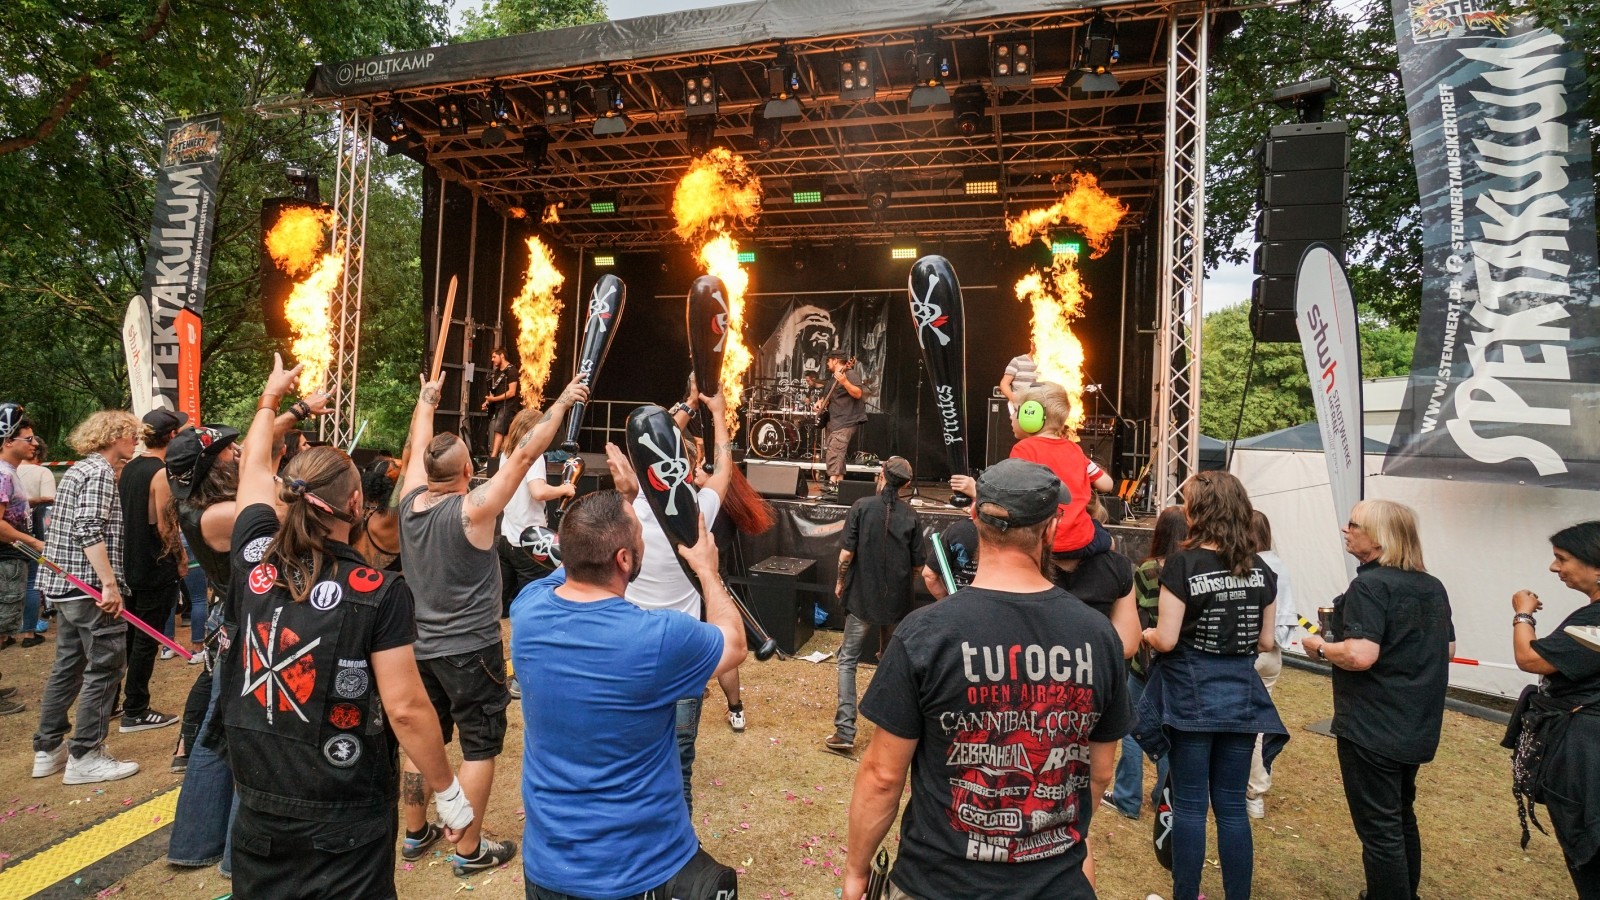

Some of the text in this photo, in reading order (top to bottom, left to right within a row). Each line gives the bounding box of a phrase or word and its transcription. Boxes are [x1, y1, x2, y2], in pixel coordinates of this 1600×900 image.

[354, 76, 372, 84] media
[355, 53, 434, 78] HOLTKAMP
[1439, 83, 1464, 250] STENNERTMUSIKERTREFF
[1446, 34, 1572, 476] SPEKTAKULUM
[151, 167, 203, 412] PEKTAKULUM
[1307, 304, 1337, 394] stwh
[1421, 280, 1462, 434] WWW.STENNERT.DE
[1333, 389, 1352, 469] STADTWERKE
[967, 685, 1010, 704] OPEN
[1020, 683, 1047, 703] AIR
[939, 710, 1043, 741] CANNIBAL
[946, 742, 1034, 774] ZEBRAHEAD
[962, 808, 1018, 827] EXPLOITED
[968, 830, 1010, 848] THE VERY
